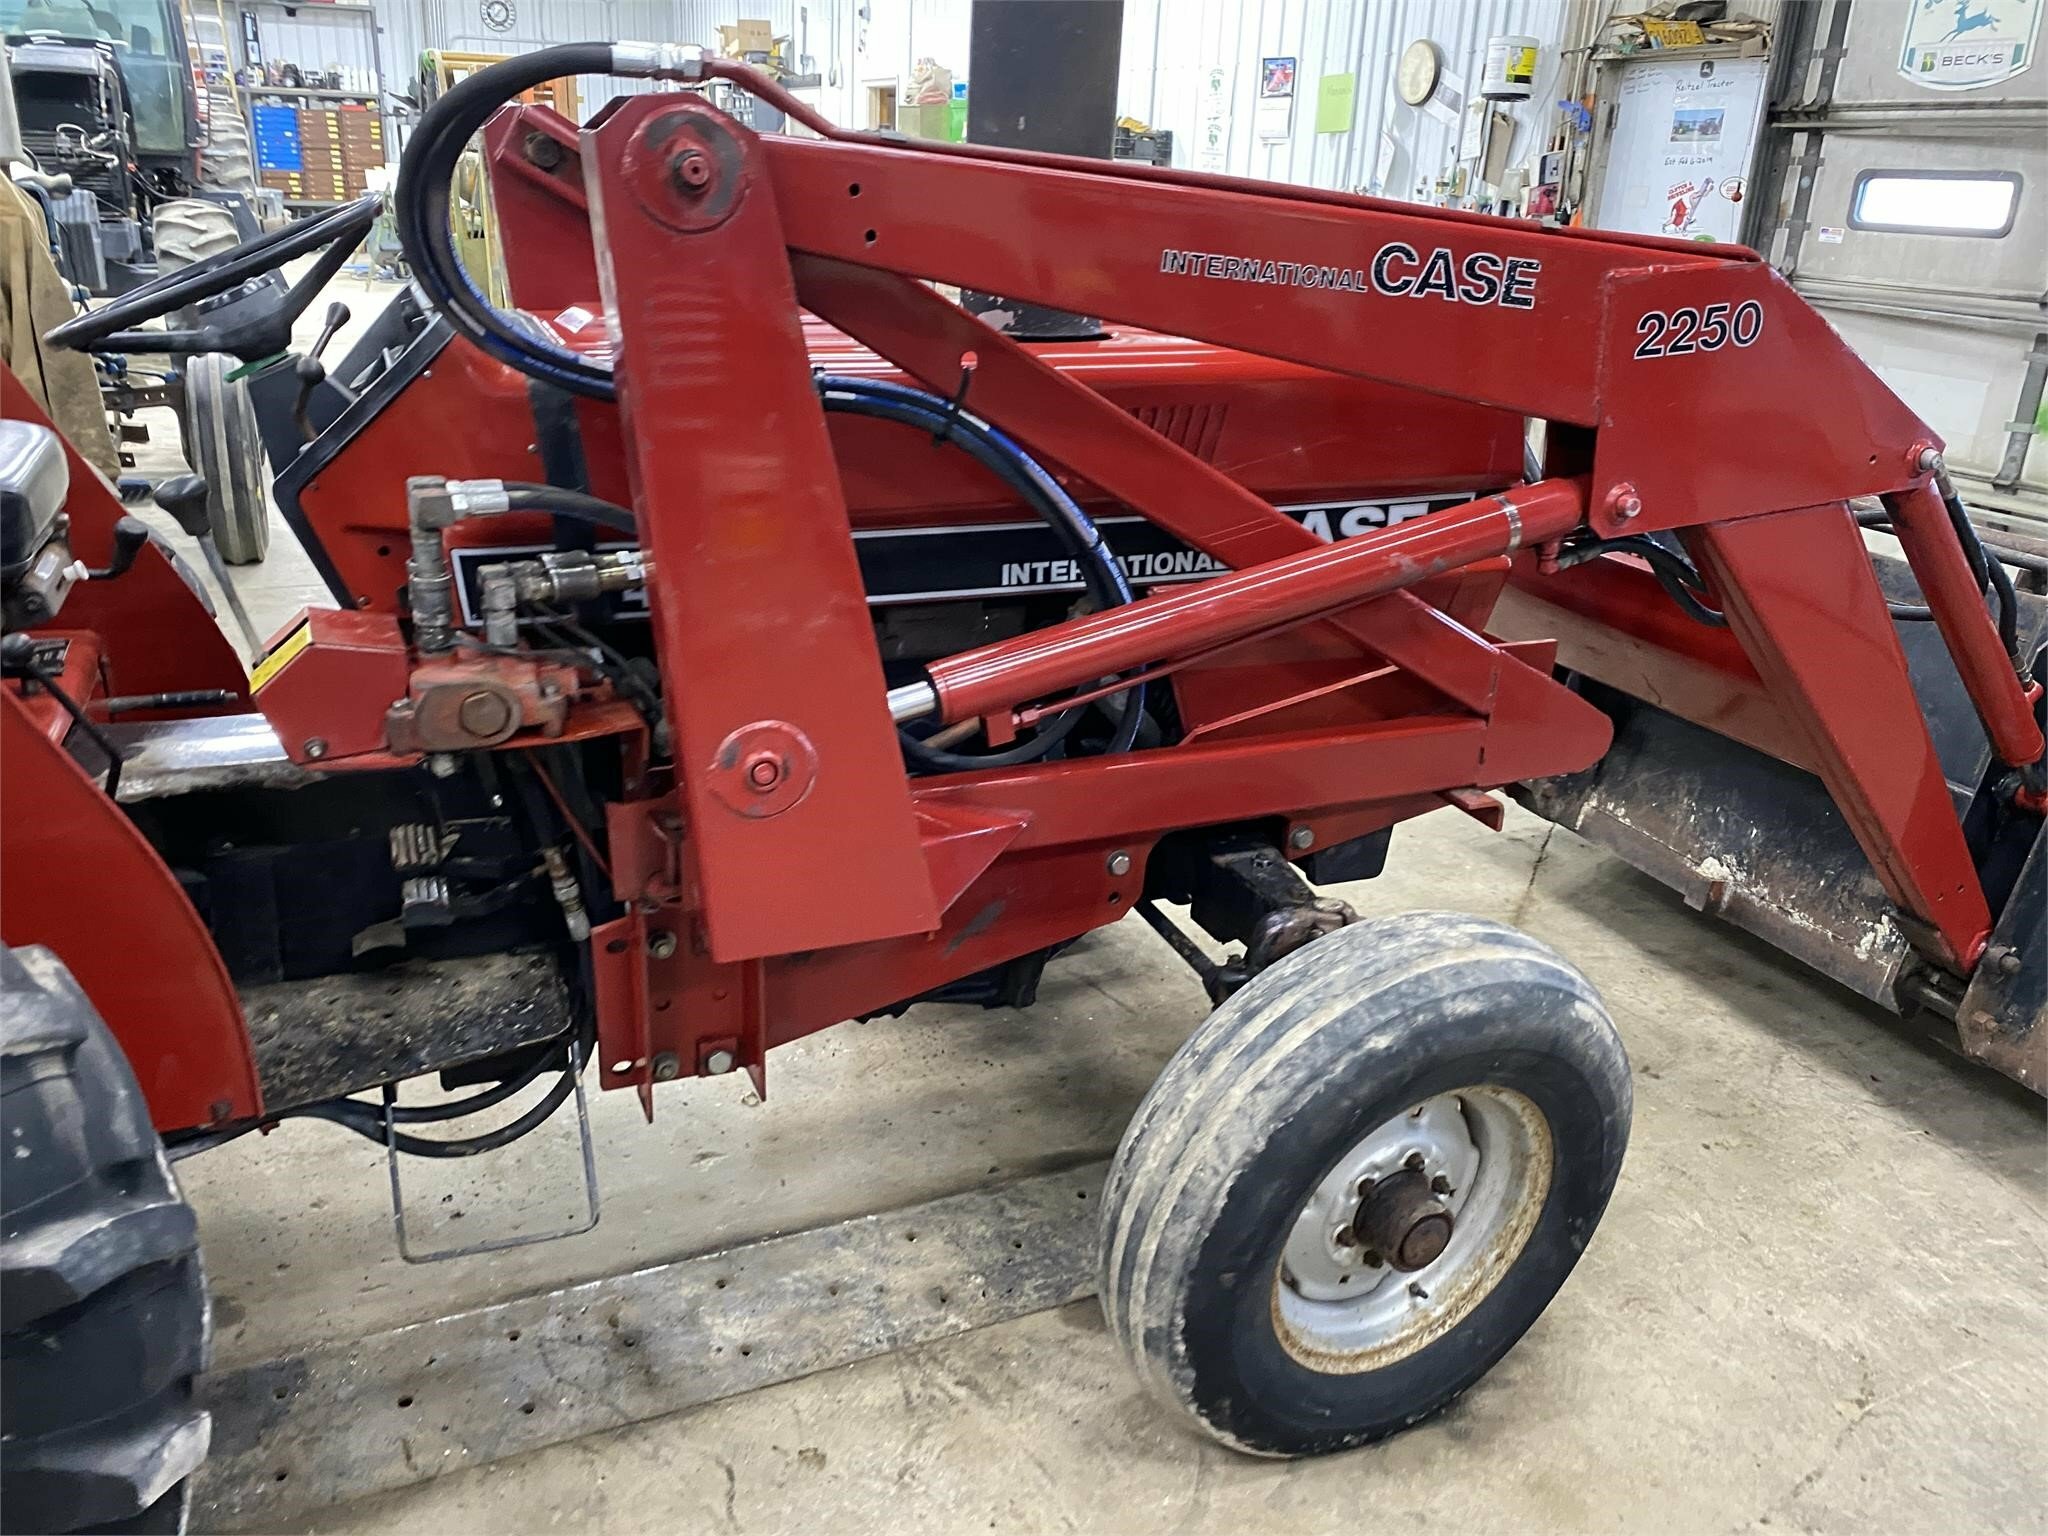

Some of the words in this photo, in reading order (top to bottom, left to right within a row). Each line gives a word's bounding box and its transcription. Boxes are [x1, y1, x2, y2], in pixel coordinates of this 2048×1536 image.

[1941, 53, 2004, 67] BECK'S
[1160, 249, 1368, 293] INTERNATIONAL
[1370, 241, 1541, 309] CASE
[1633, 299, 1764, 360] 2250
